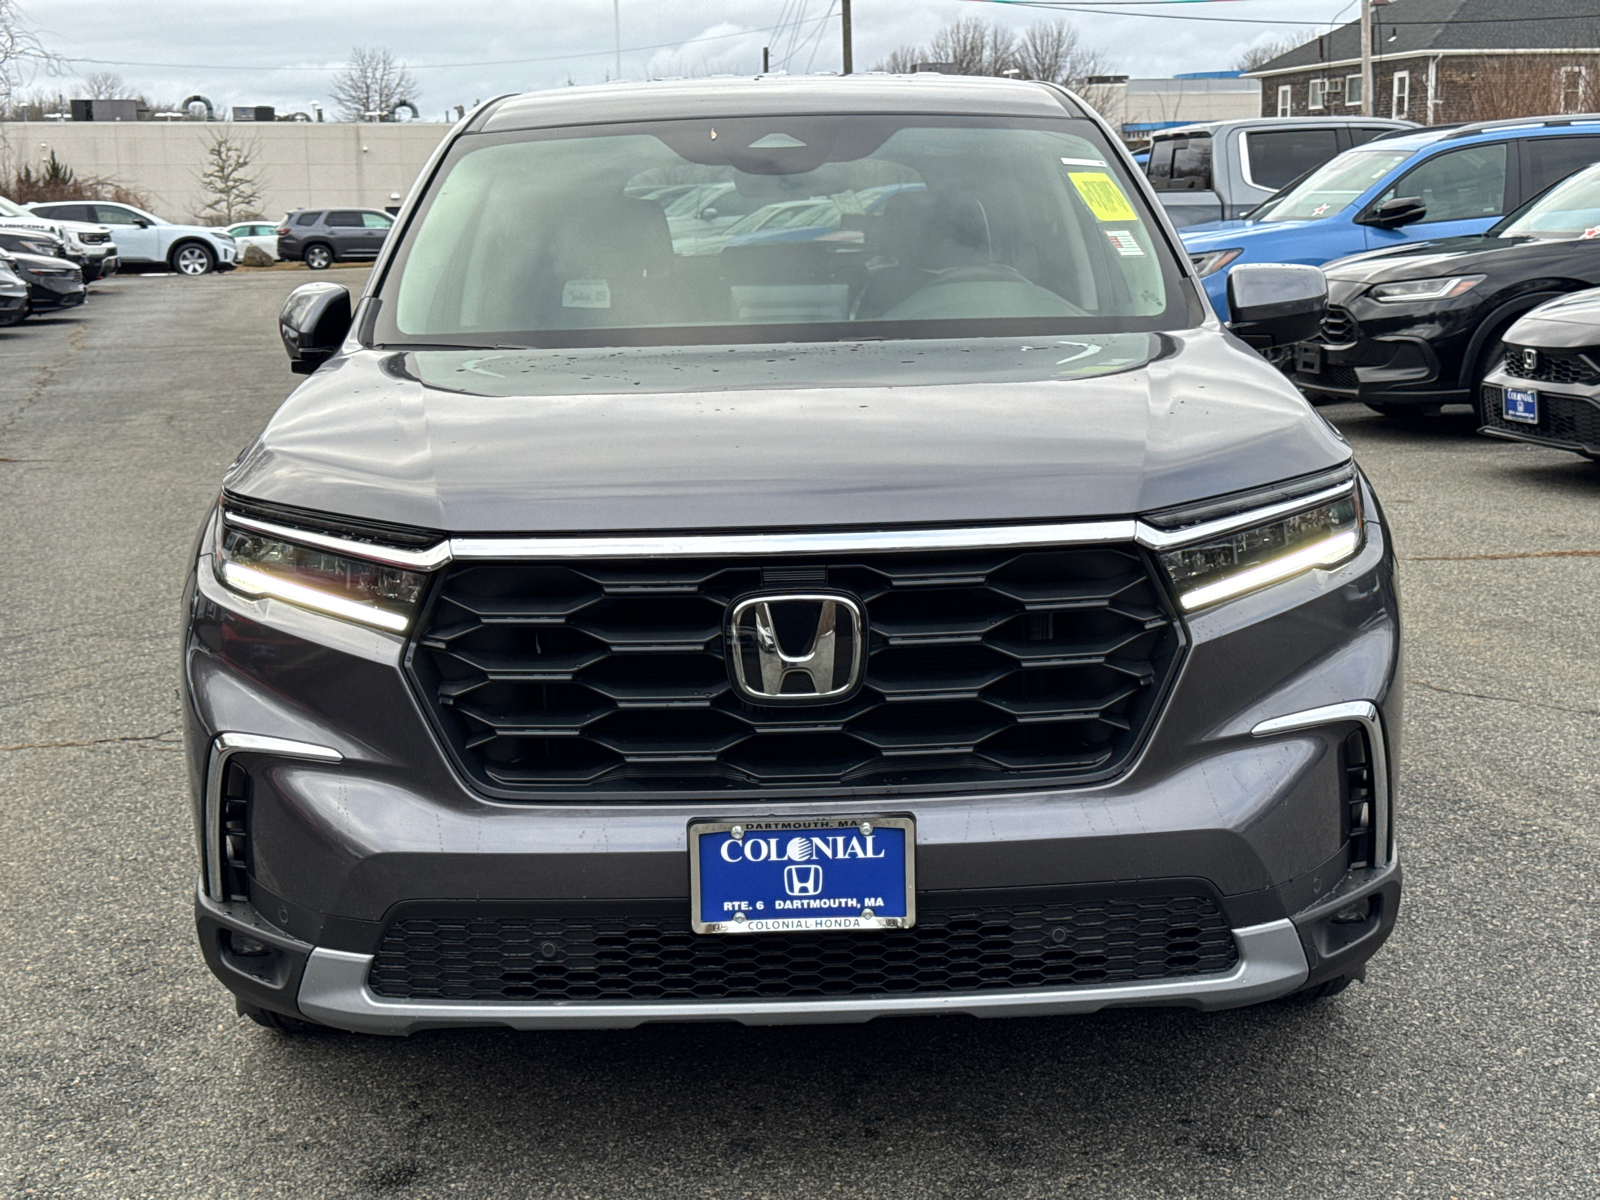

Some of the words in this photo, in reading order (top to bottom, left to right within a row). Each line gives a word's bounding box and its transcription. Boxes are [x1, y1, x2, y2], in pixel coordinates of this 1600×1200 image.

[837, 820, 858, 828] MA
[720, 835, 885, 863] COLONIAL
[723, 901, 753, 911] RTE.
[755, 901, 765, 910] 6
[775, 897, 861, 909] DARTMOUTH,
[864, 897, 885, 907] MA
[747, 921, 811, 931] COLONIAL
[815, 919, 860, 929] HONDA
